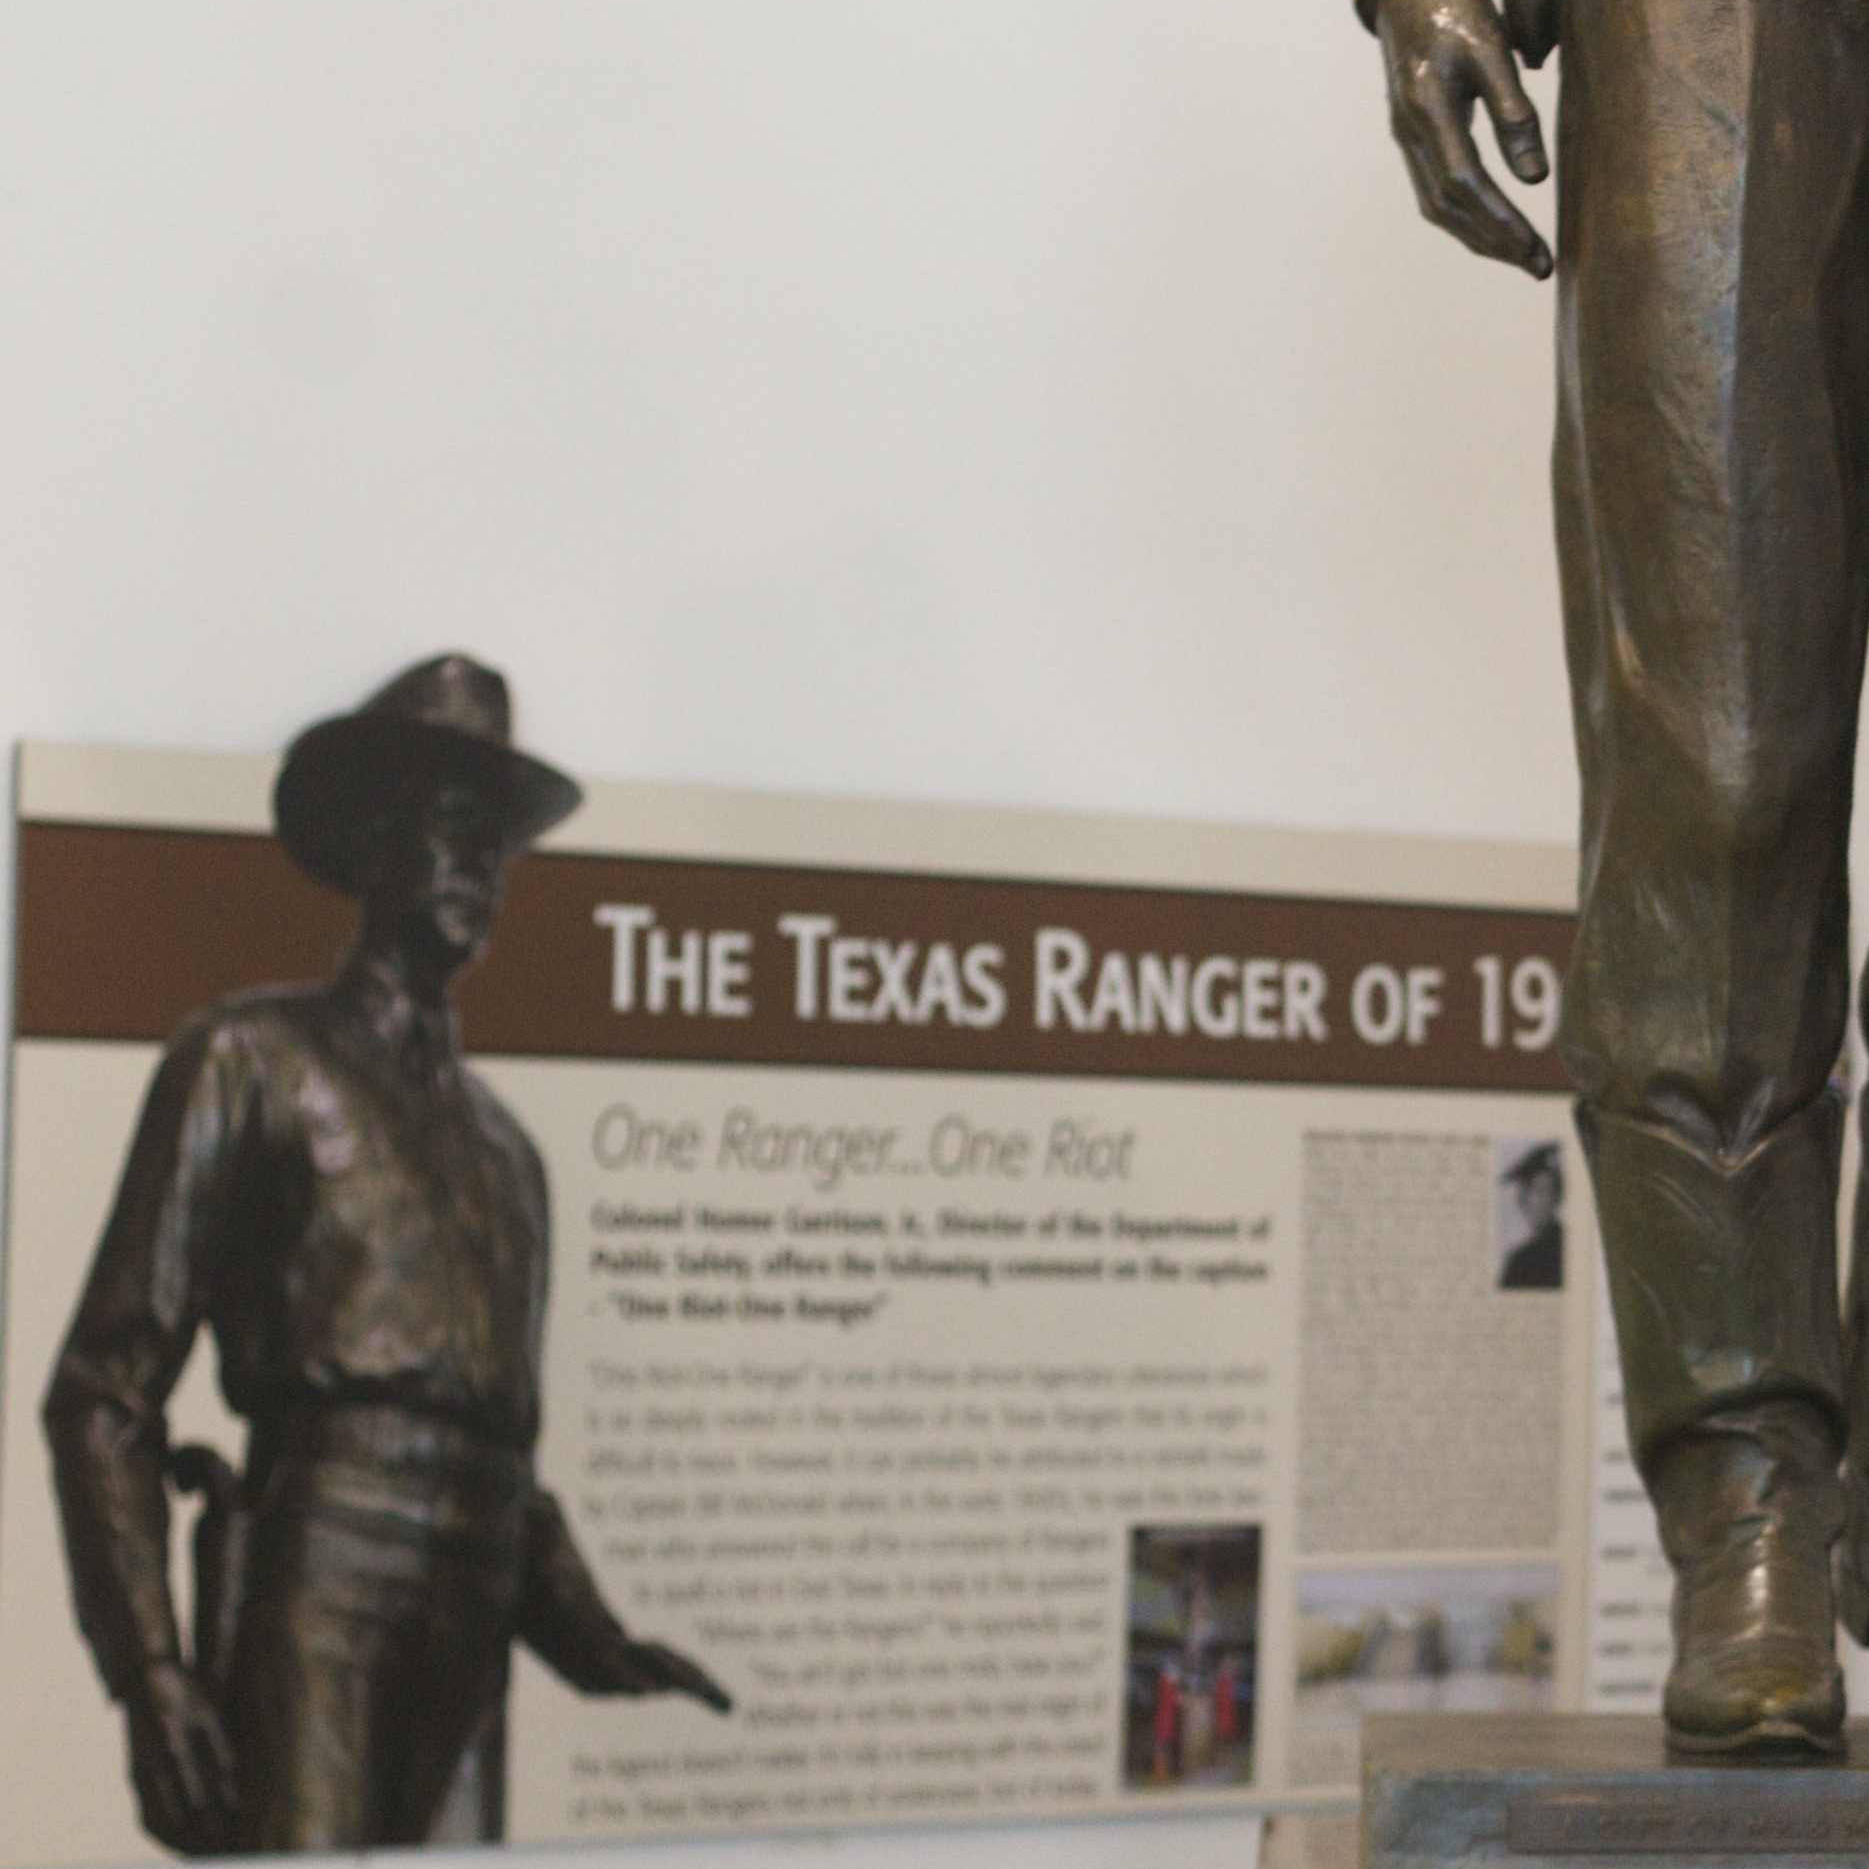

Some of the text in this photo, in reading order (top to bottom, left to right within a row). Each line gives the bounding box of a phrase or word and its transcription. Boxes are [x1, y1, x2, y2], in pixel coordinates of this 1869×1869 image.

[595, 904, 753, 1018] THE
[777, 914, 1005, 1028] TEXAS
[1033, 928, 1328, 1042] RANGER
[1351, 962, 1445, 1047] OF
[592, 1101, 703, 1172] One
[1046, 1116, 1136, 1180] Riot
